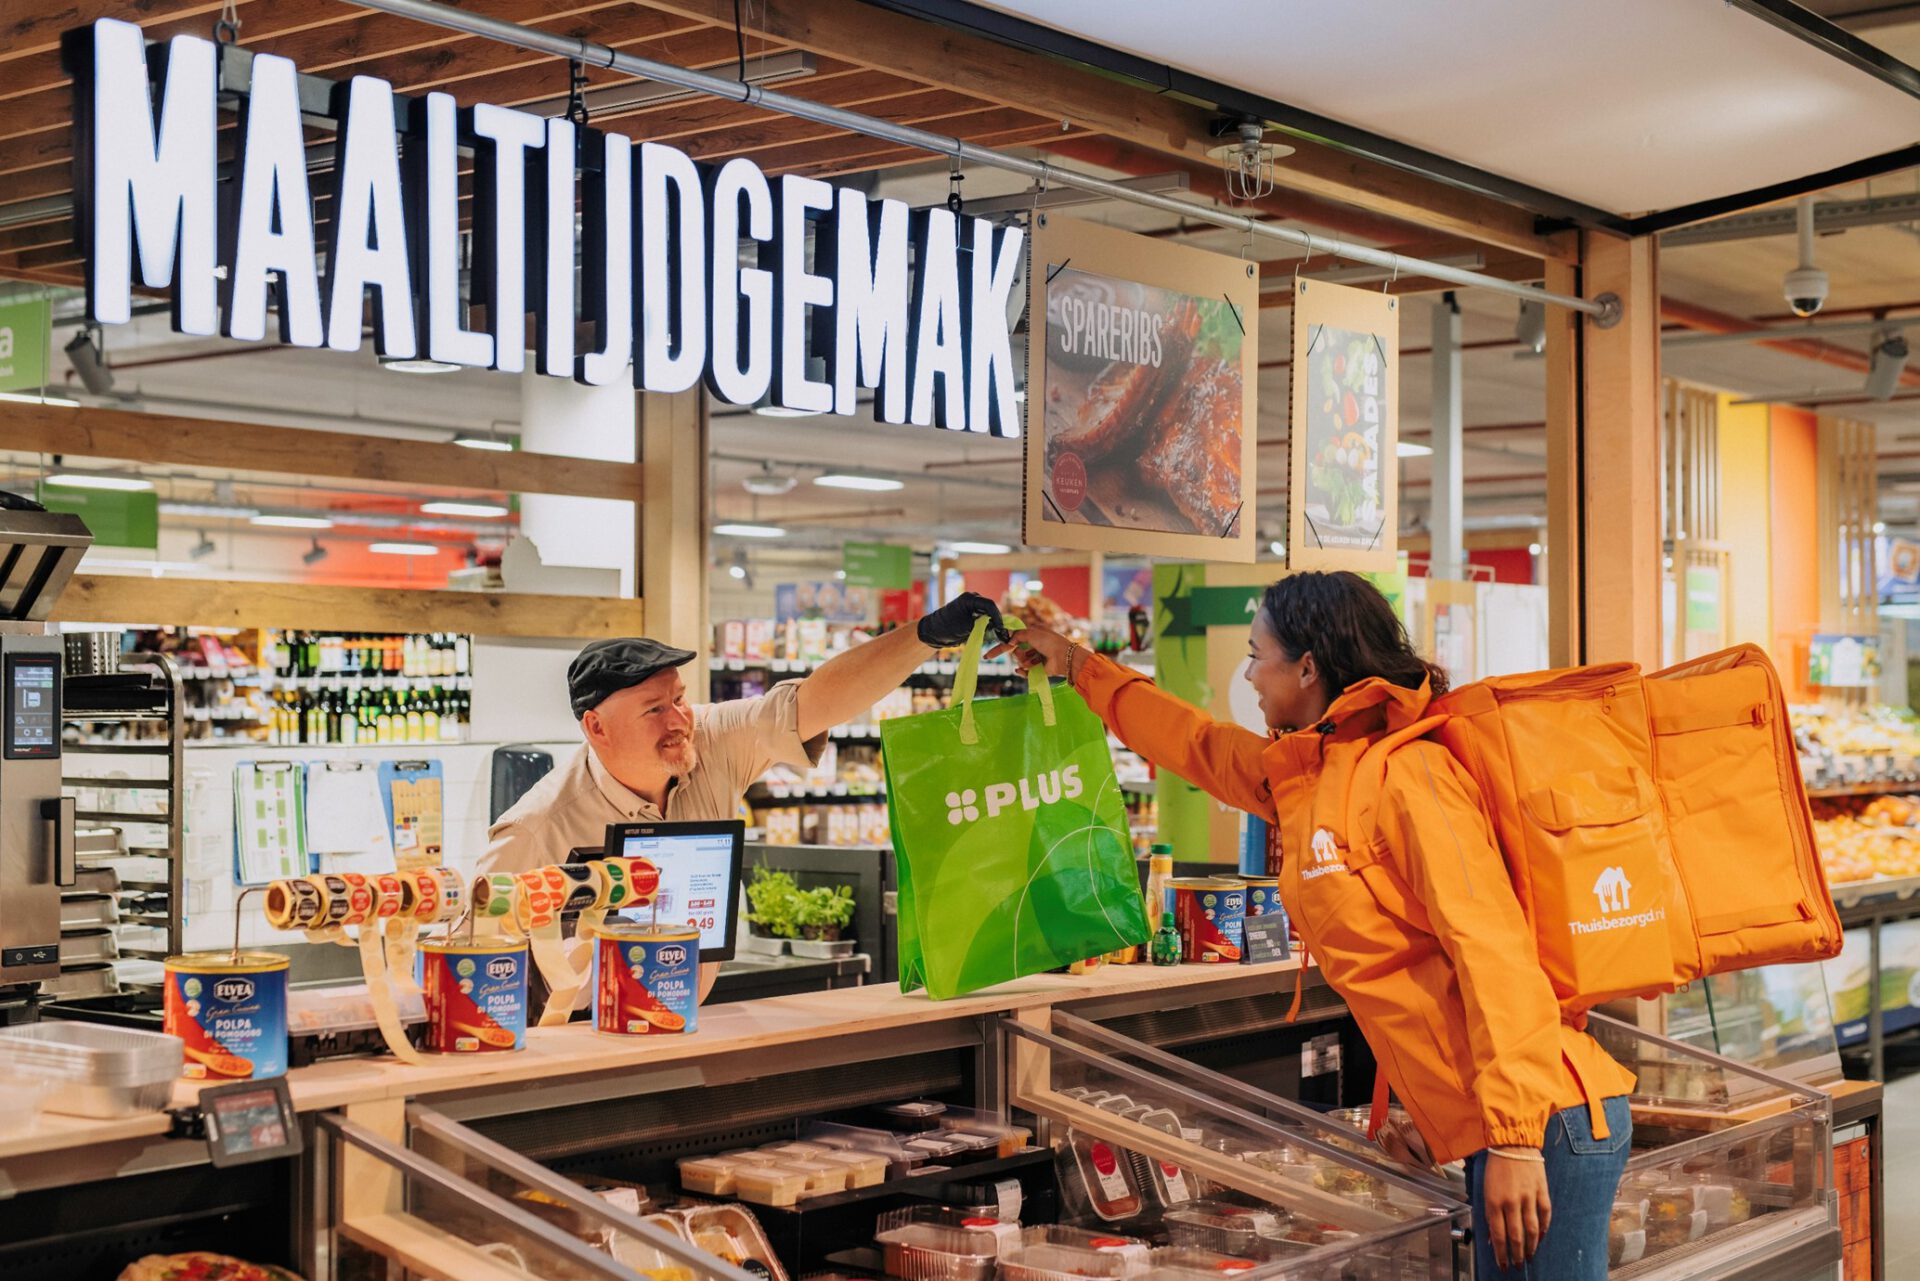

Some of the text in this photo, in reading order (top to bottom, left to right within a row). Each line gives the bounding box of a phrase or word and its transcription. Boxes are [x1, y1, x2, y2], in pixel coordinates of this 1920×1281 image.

[93, 17, 1024, 438] MAALTIJDGEMAK
[1061, 295, 1162, 369] SPARERIBS
[1362, 352, 1379, 522] SALADES
[1056, 477, 1082, 488] KEUKEN
[984, 764, 1083, 818] PLUS
[1302, 863, 1349, 880] Thuisbezor
[1568, 907, 1665, 935] Thuisbezorgd.nl
[659, 950, 685, 961] ELVEA
[490, 963, 515, 974] ELVEA
[217, 985, 252, 996] ELVEA
[657, 980, 685, 990] POLPA
[488, 995, 515, 1004] POLPA
[647, 991, 656, 999] DI
[215, 1018, 252, 1030] POLPA
